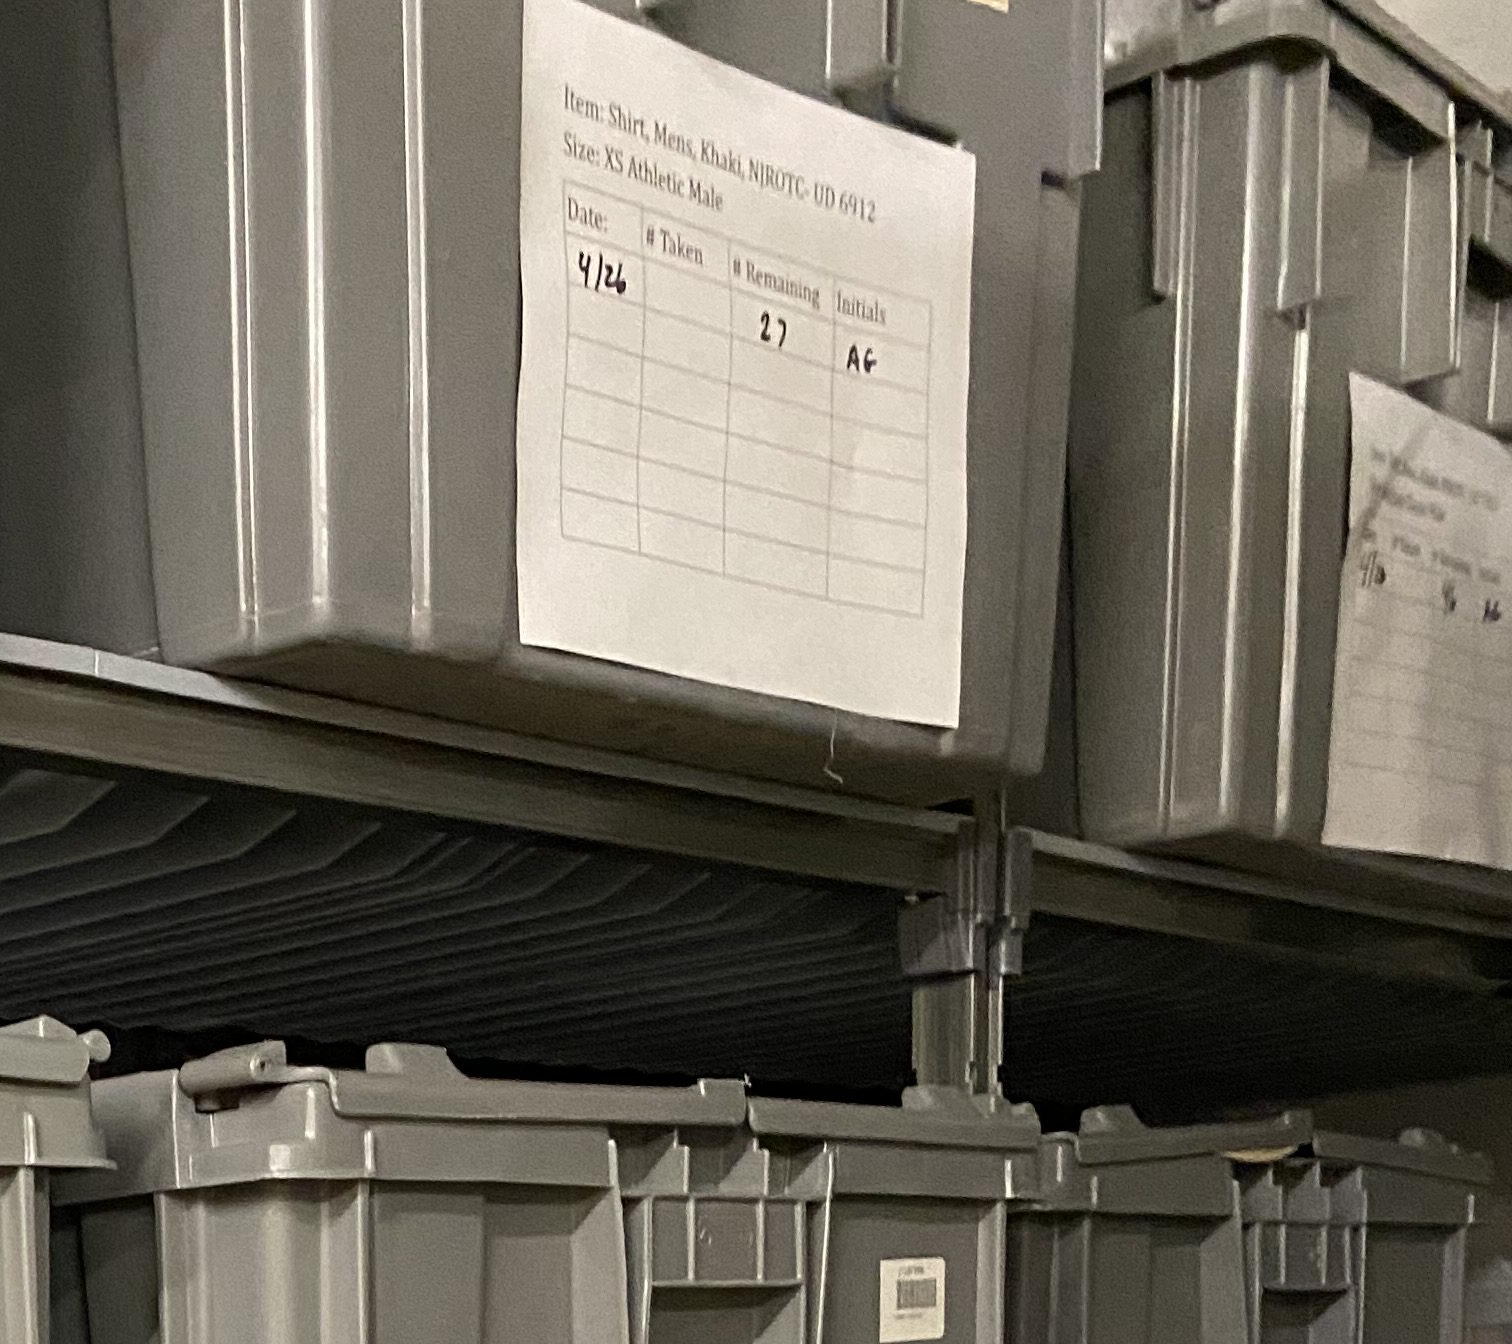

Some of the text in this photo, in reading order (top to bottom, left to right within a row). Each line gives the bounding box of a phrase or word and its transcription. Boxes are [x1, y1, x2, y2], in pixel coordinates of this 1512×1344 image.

[563, 132, 723, 212] Size: XS Athletic Male
[564, 84, 877, 224] Item: Shirt, Mens, Khaki, NJROTC- UD 6912
[567, 197, 608, 233] Date:
[646, 223, 704, 266] # Taken
[577, 249, 627, 296] 4/26
[732, 257, 821, 310] # Remaining
[760, 311, 788, 348] 27
[837, 290, 887, 325] Initials
